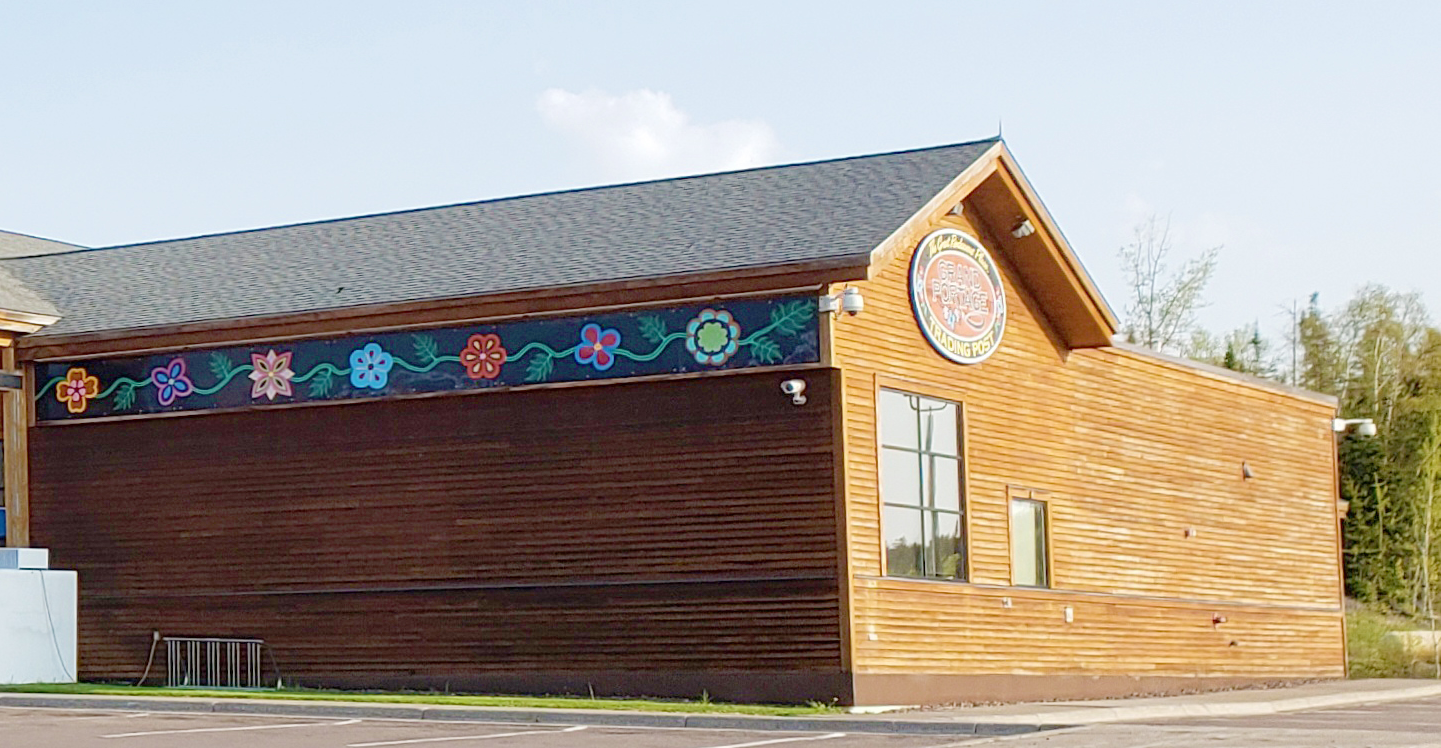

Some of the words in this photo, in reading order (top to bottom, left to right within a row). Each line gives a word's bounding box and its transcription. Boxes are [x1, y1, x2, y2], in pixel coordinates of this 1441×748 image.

[938, 259, 982, 292] GRAND
[931, 278, 989, 315] PORTAGE
[929, 317, 971, 357] TRADING
[971, 331, 996, 357] POST
